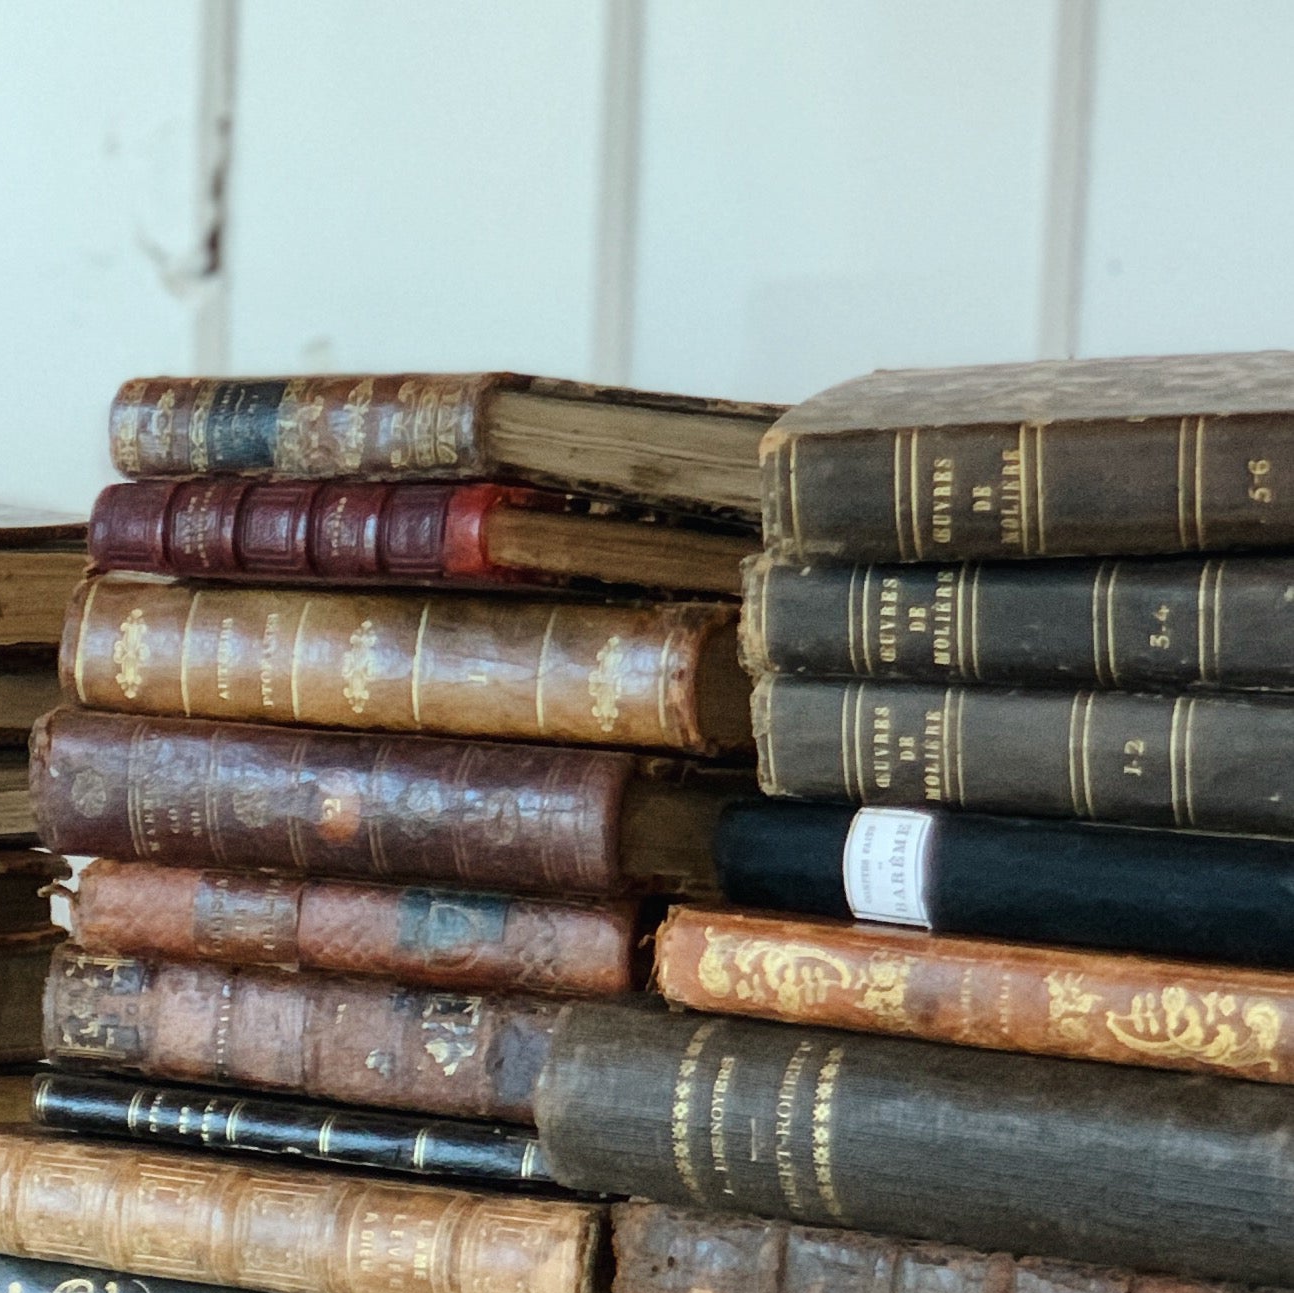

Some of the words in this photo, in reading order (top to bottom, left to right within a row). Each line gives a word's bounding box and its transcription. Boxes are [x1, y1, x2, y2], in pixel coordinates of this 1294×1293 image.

[932, 457, 952, 543] ŒUVRES
[972, 486, 992, 512] DE
[1248, 459, 1271, 503] 5-6
[879, 576, 897, 662] ŒUVRES
[908, 606, 927, 632] DE
[874, 706, 891, 788] ŒUVRES
[899, 736, 916, 761] DE
[321, 797, 342, 821] 2
[888, 823, 912, 912] BARÊME
